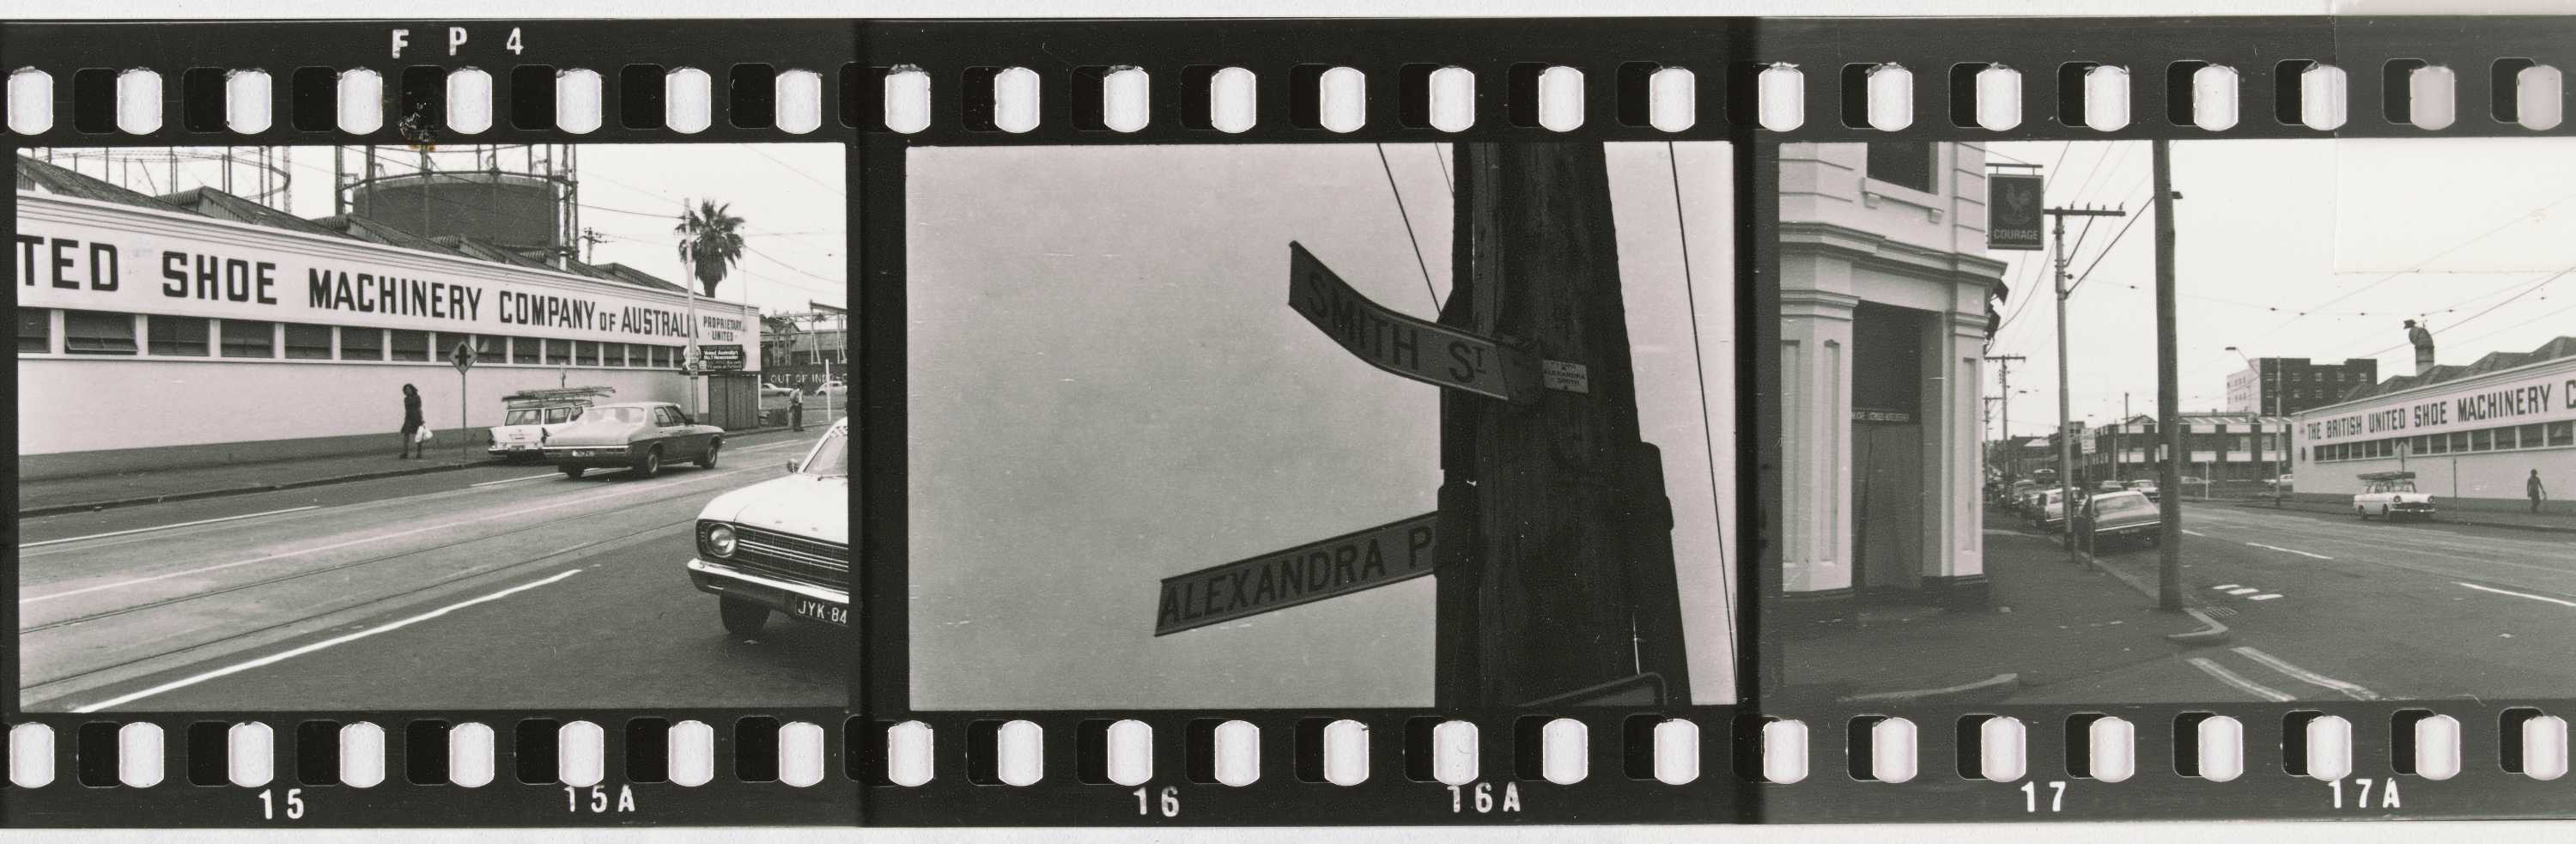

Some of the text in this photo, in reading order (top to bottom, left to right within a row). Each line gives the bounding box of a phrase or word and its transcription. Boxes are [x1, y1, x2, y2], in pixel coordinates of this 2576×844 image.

[1993, 228, 2038, 240] COURAGE
[16, 234, 118, 292] TED
[161, 250, 277, 305] SHOE
[308, 267, 483, 321] MACHINERY
[499, 290, 596, 331] COMPANY
[703, 315, 743, 331] PROPRIETARY
[712, 330, 734, 342] LIMITED
[1307, 269, 1419, 371] SMITH
[770, 373, 792, 385] OUT
[2307, 421, 2322, 440] THE
[2326, 415, 2362, 439] BRITISH
[2368, 407, 2405, 433] UNITED
[2414, 400, 2447, 428] SHOE
[2458, 383, 2552, 422] MACHINERY
[1157, 537, 1386, 627] ALEXANDRA
[258, 787, 305, 820] 15
[564, 786, 636, 813] 15A
[1133, 785, 1180, 818] 16
[1446, 781, 1521, 814] 16A
[2020, 780, 2066, 813] 17
[2327, 777, 2401, 809] 17A
